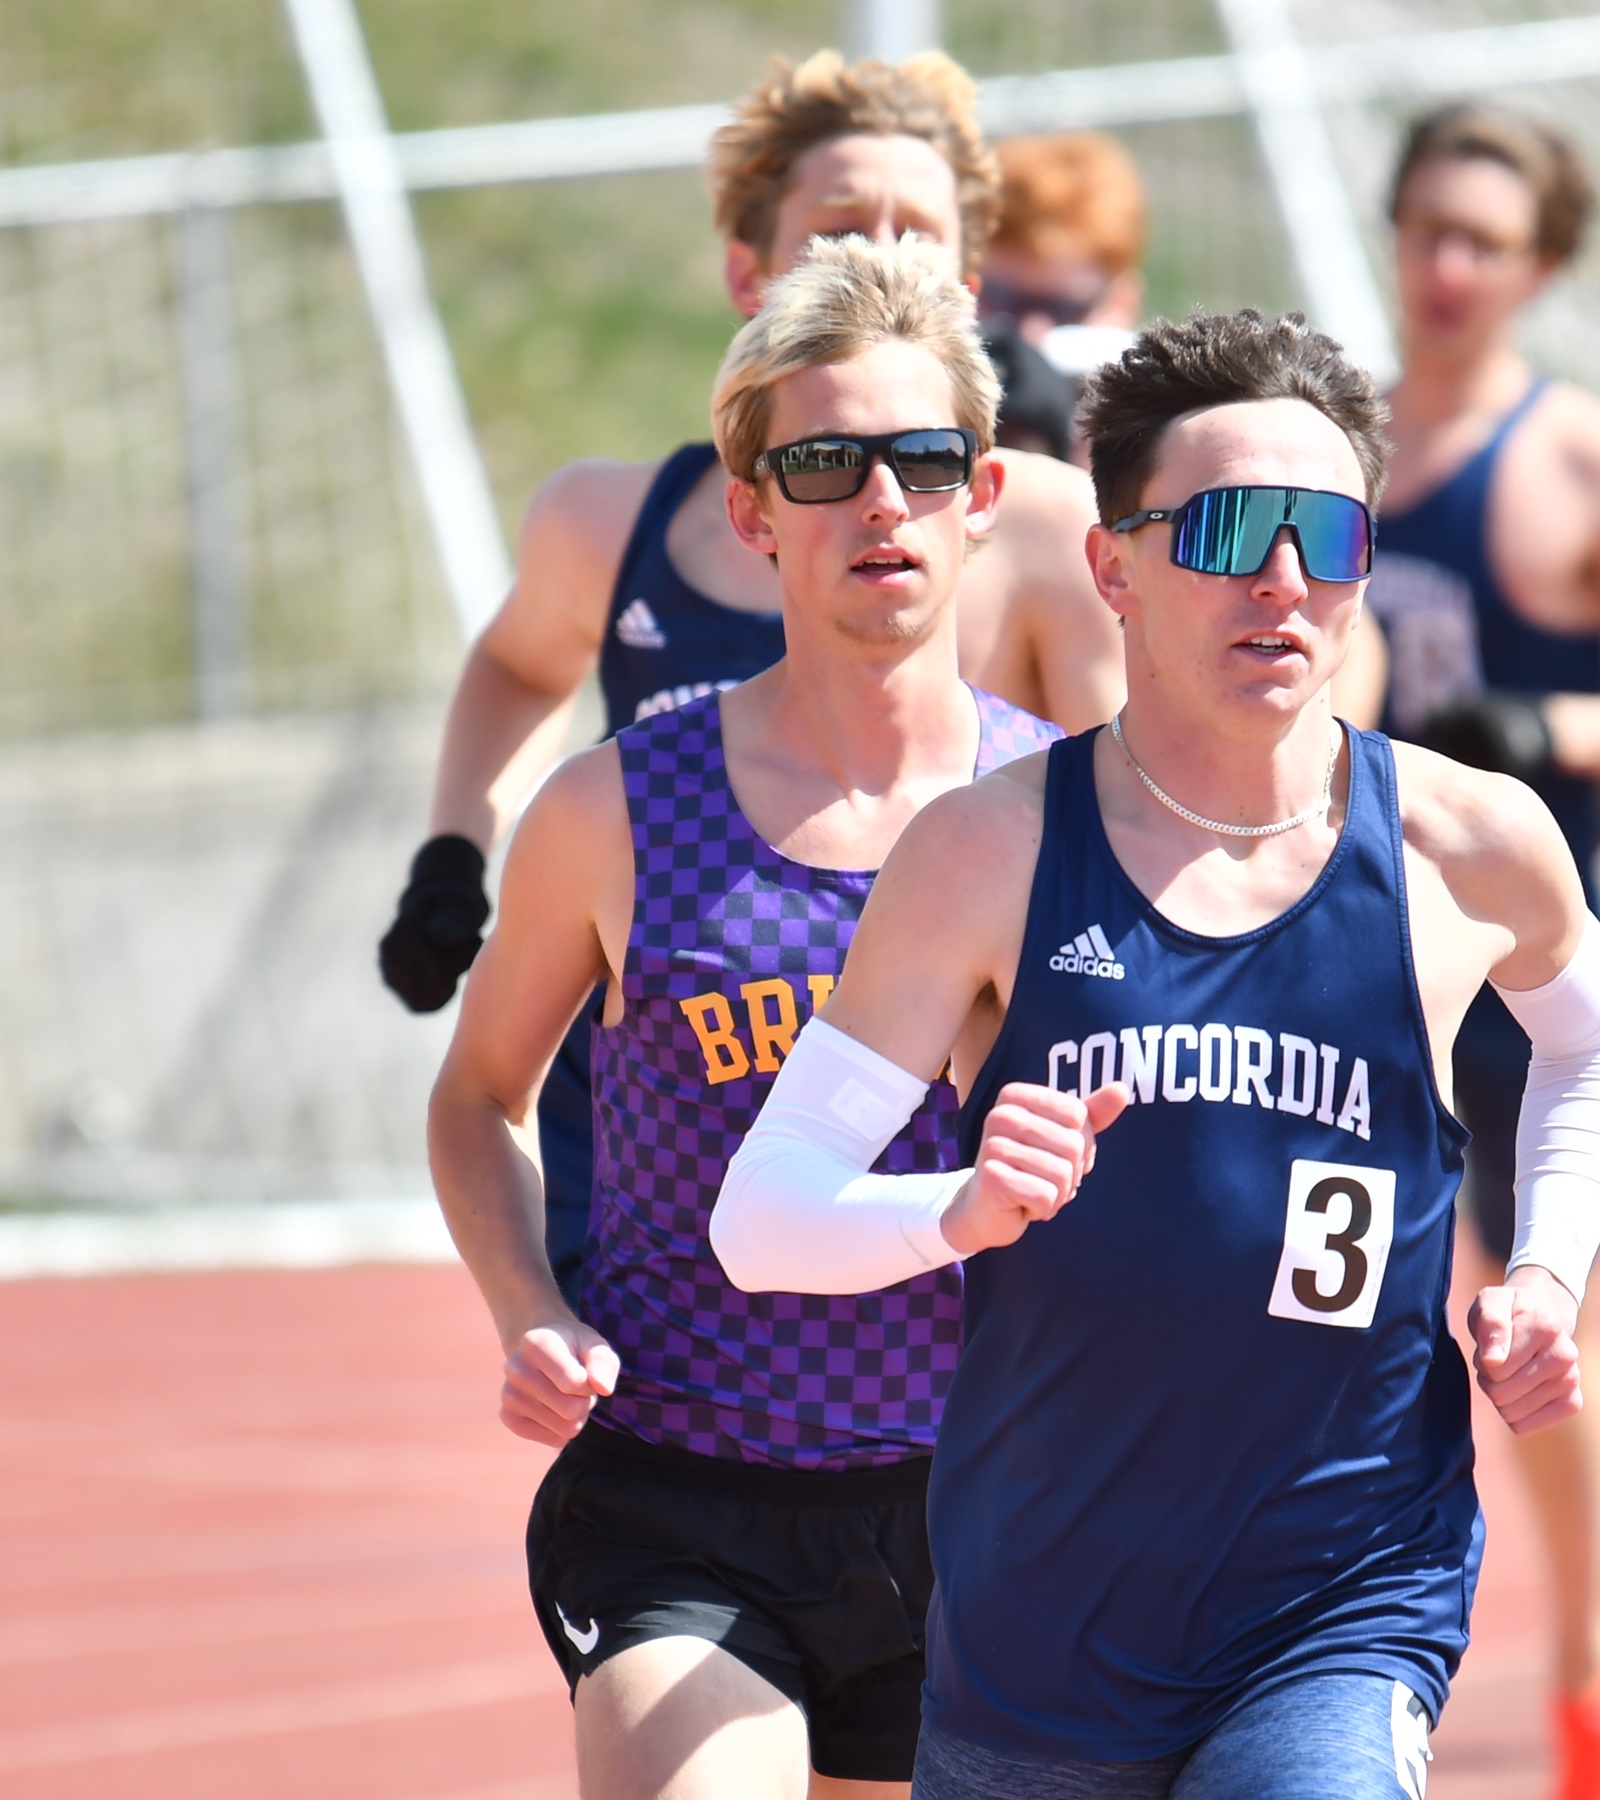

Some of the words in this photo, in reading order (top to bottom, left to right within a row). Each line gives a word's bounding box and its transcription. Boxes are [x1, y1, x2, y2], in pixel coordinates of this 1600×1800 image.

[1049, 953, 1125, 980] adidas
[679, 974, 838, 1086] BR
[1048, 1022, 1371, 1142] CONCORDIA
[1291, 1176, 1373, 1313] 3
